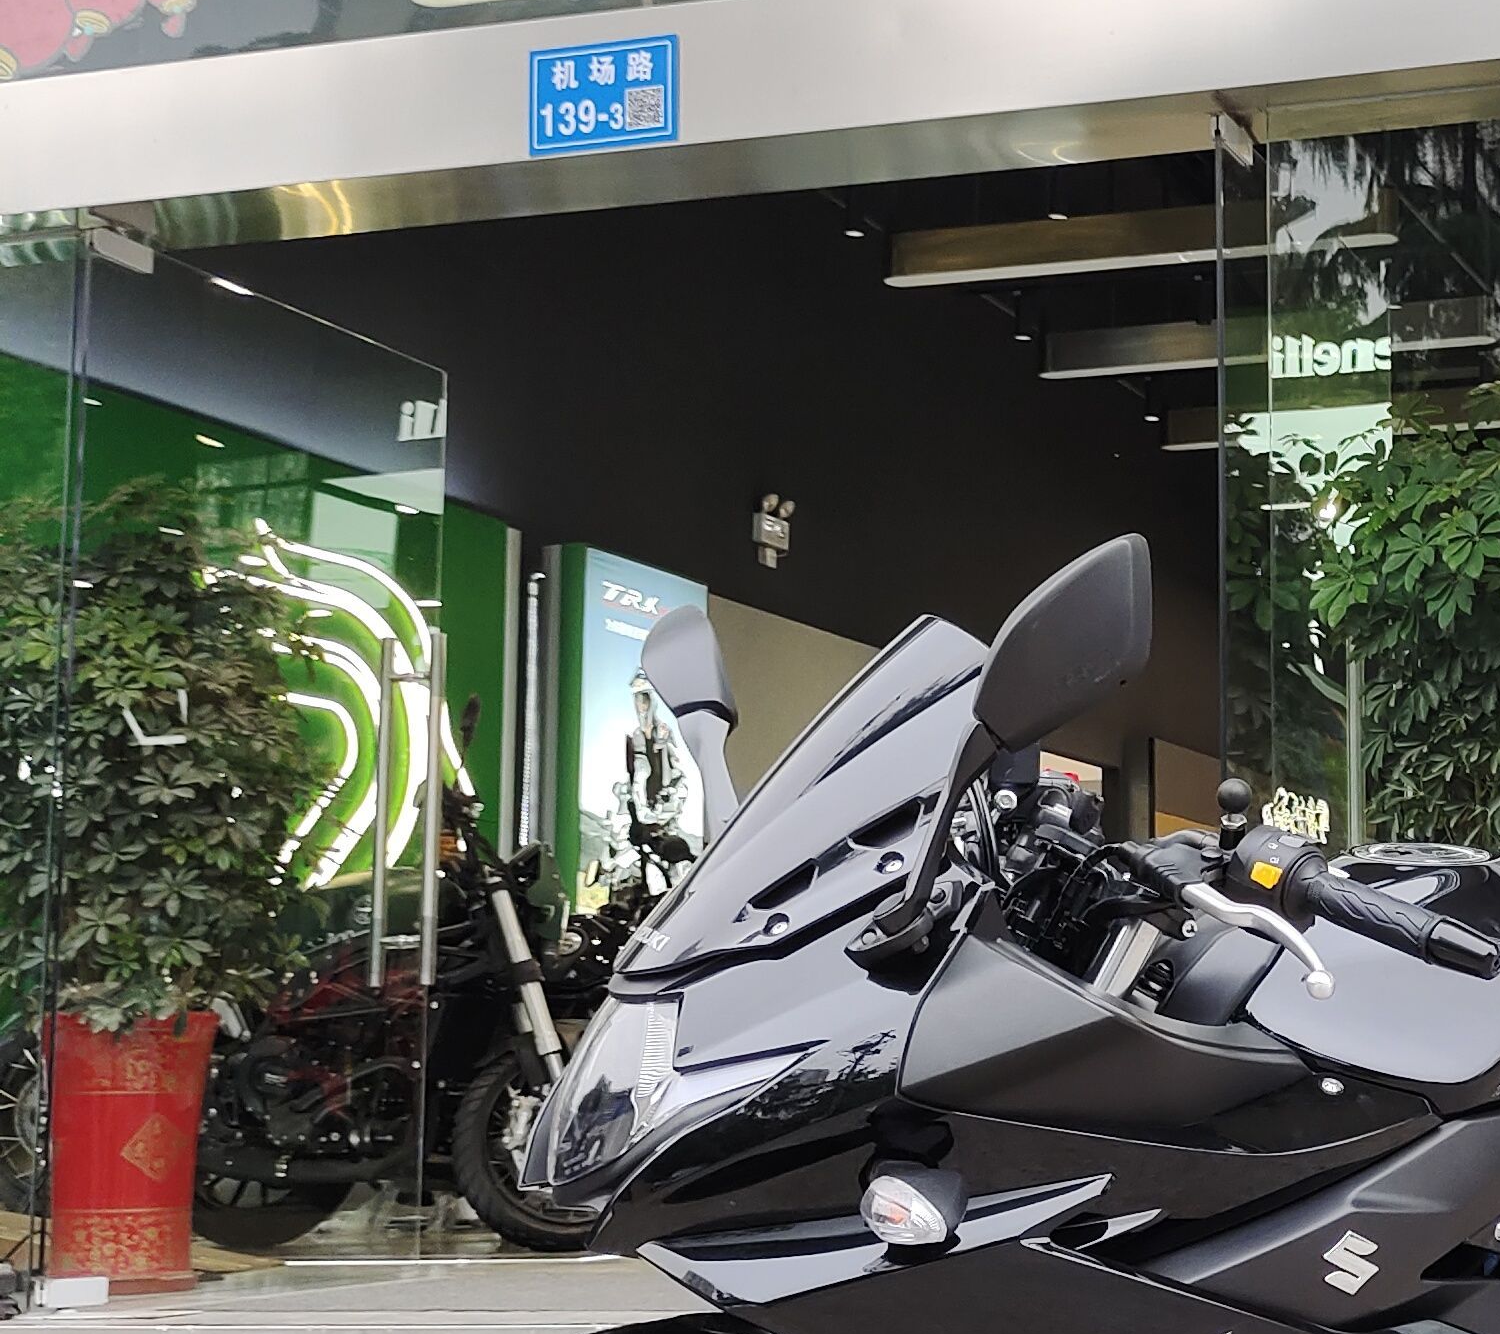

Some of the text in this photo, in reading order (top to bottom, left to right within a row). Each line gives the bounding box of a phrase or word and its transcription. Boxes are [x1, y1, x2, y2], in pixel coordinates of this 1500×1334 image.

[551, 50, 654, 91] 机场路
[539, 100, 625, 138] 139-3
